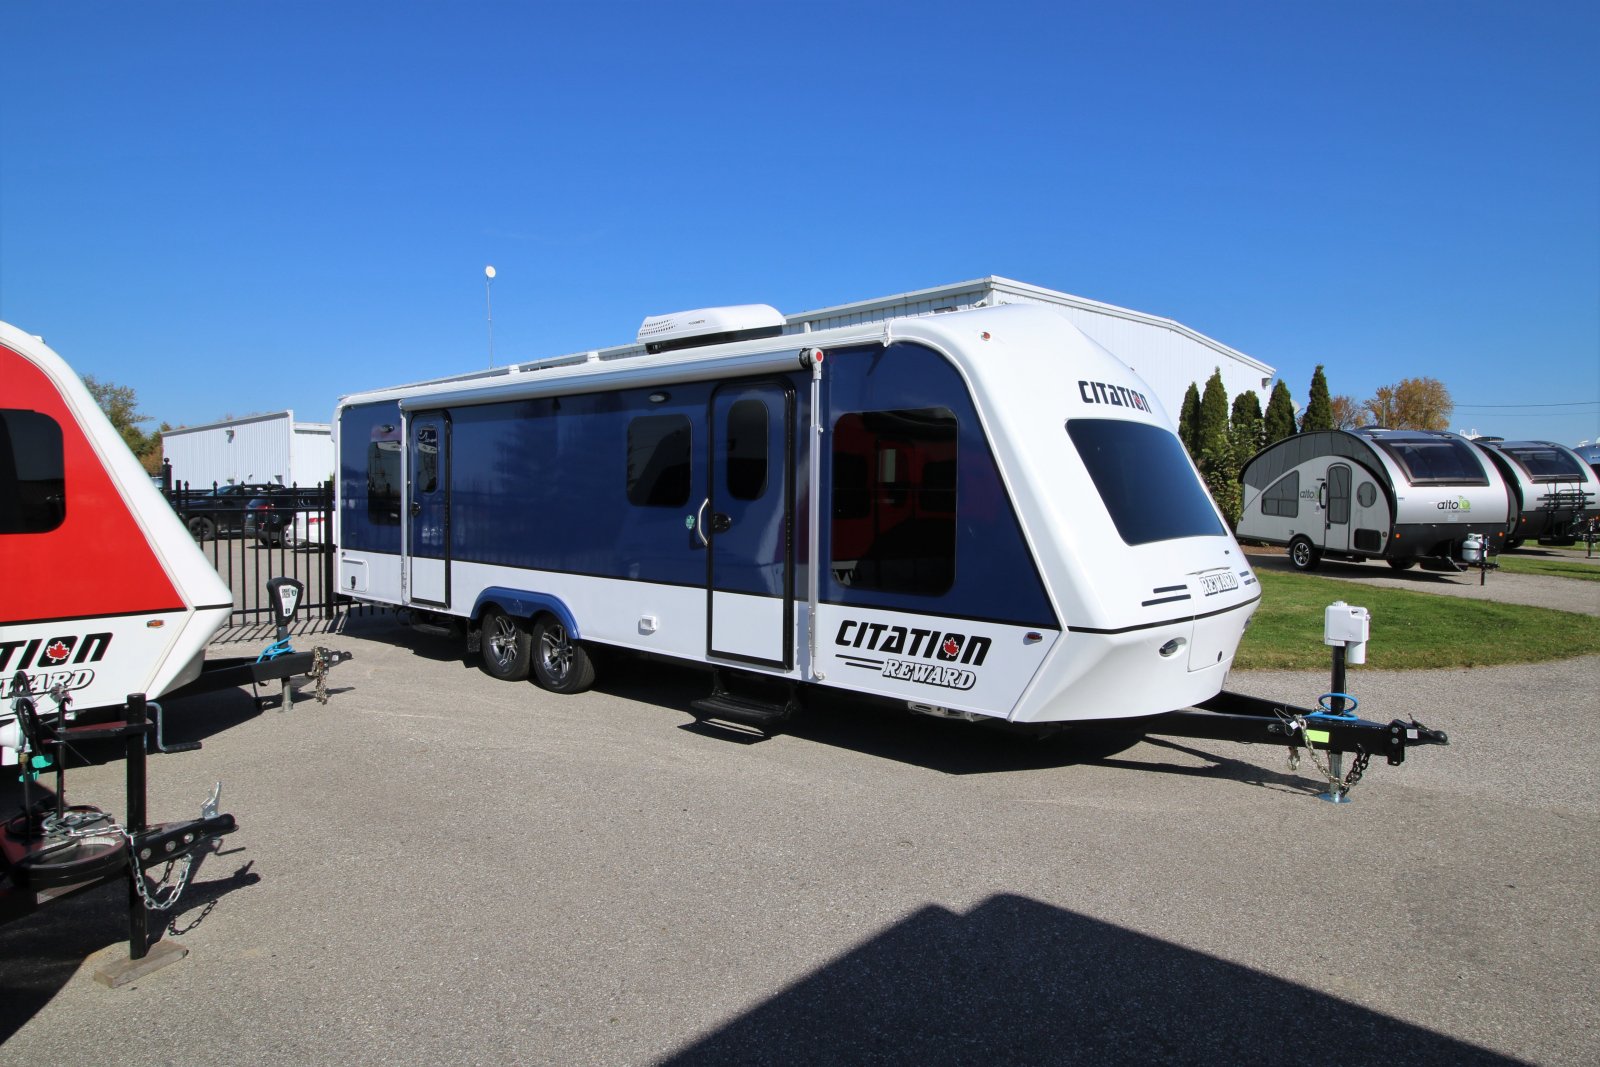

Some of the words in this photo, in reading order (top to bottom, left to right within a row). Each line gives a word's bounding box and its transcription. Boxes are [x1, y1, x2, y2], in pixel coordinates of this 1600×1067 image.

[1437, 499, 1459, 510] alto
[1199, 571, 1238, 597] REWARD
[835, 619, 992, 666] CITATION
[882, 658, 976, 691] REWARD
